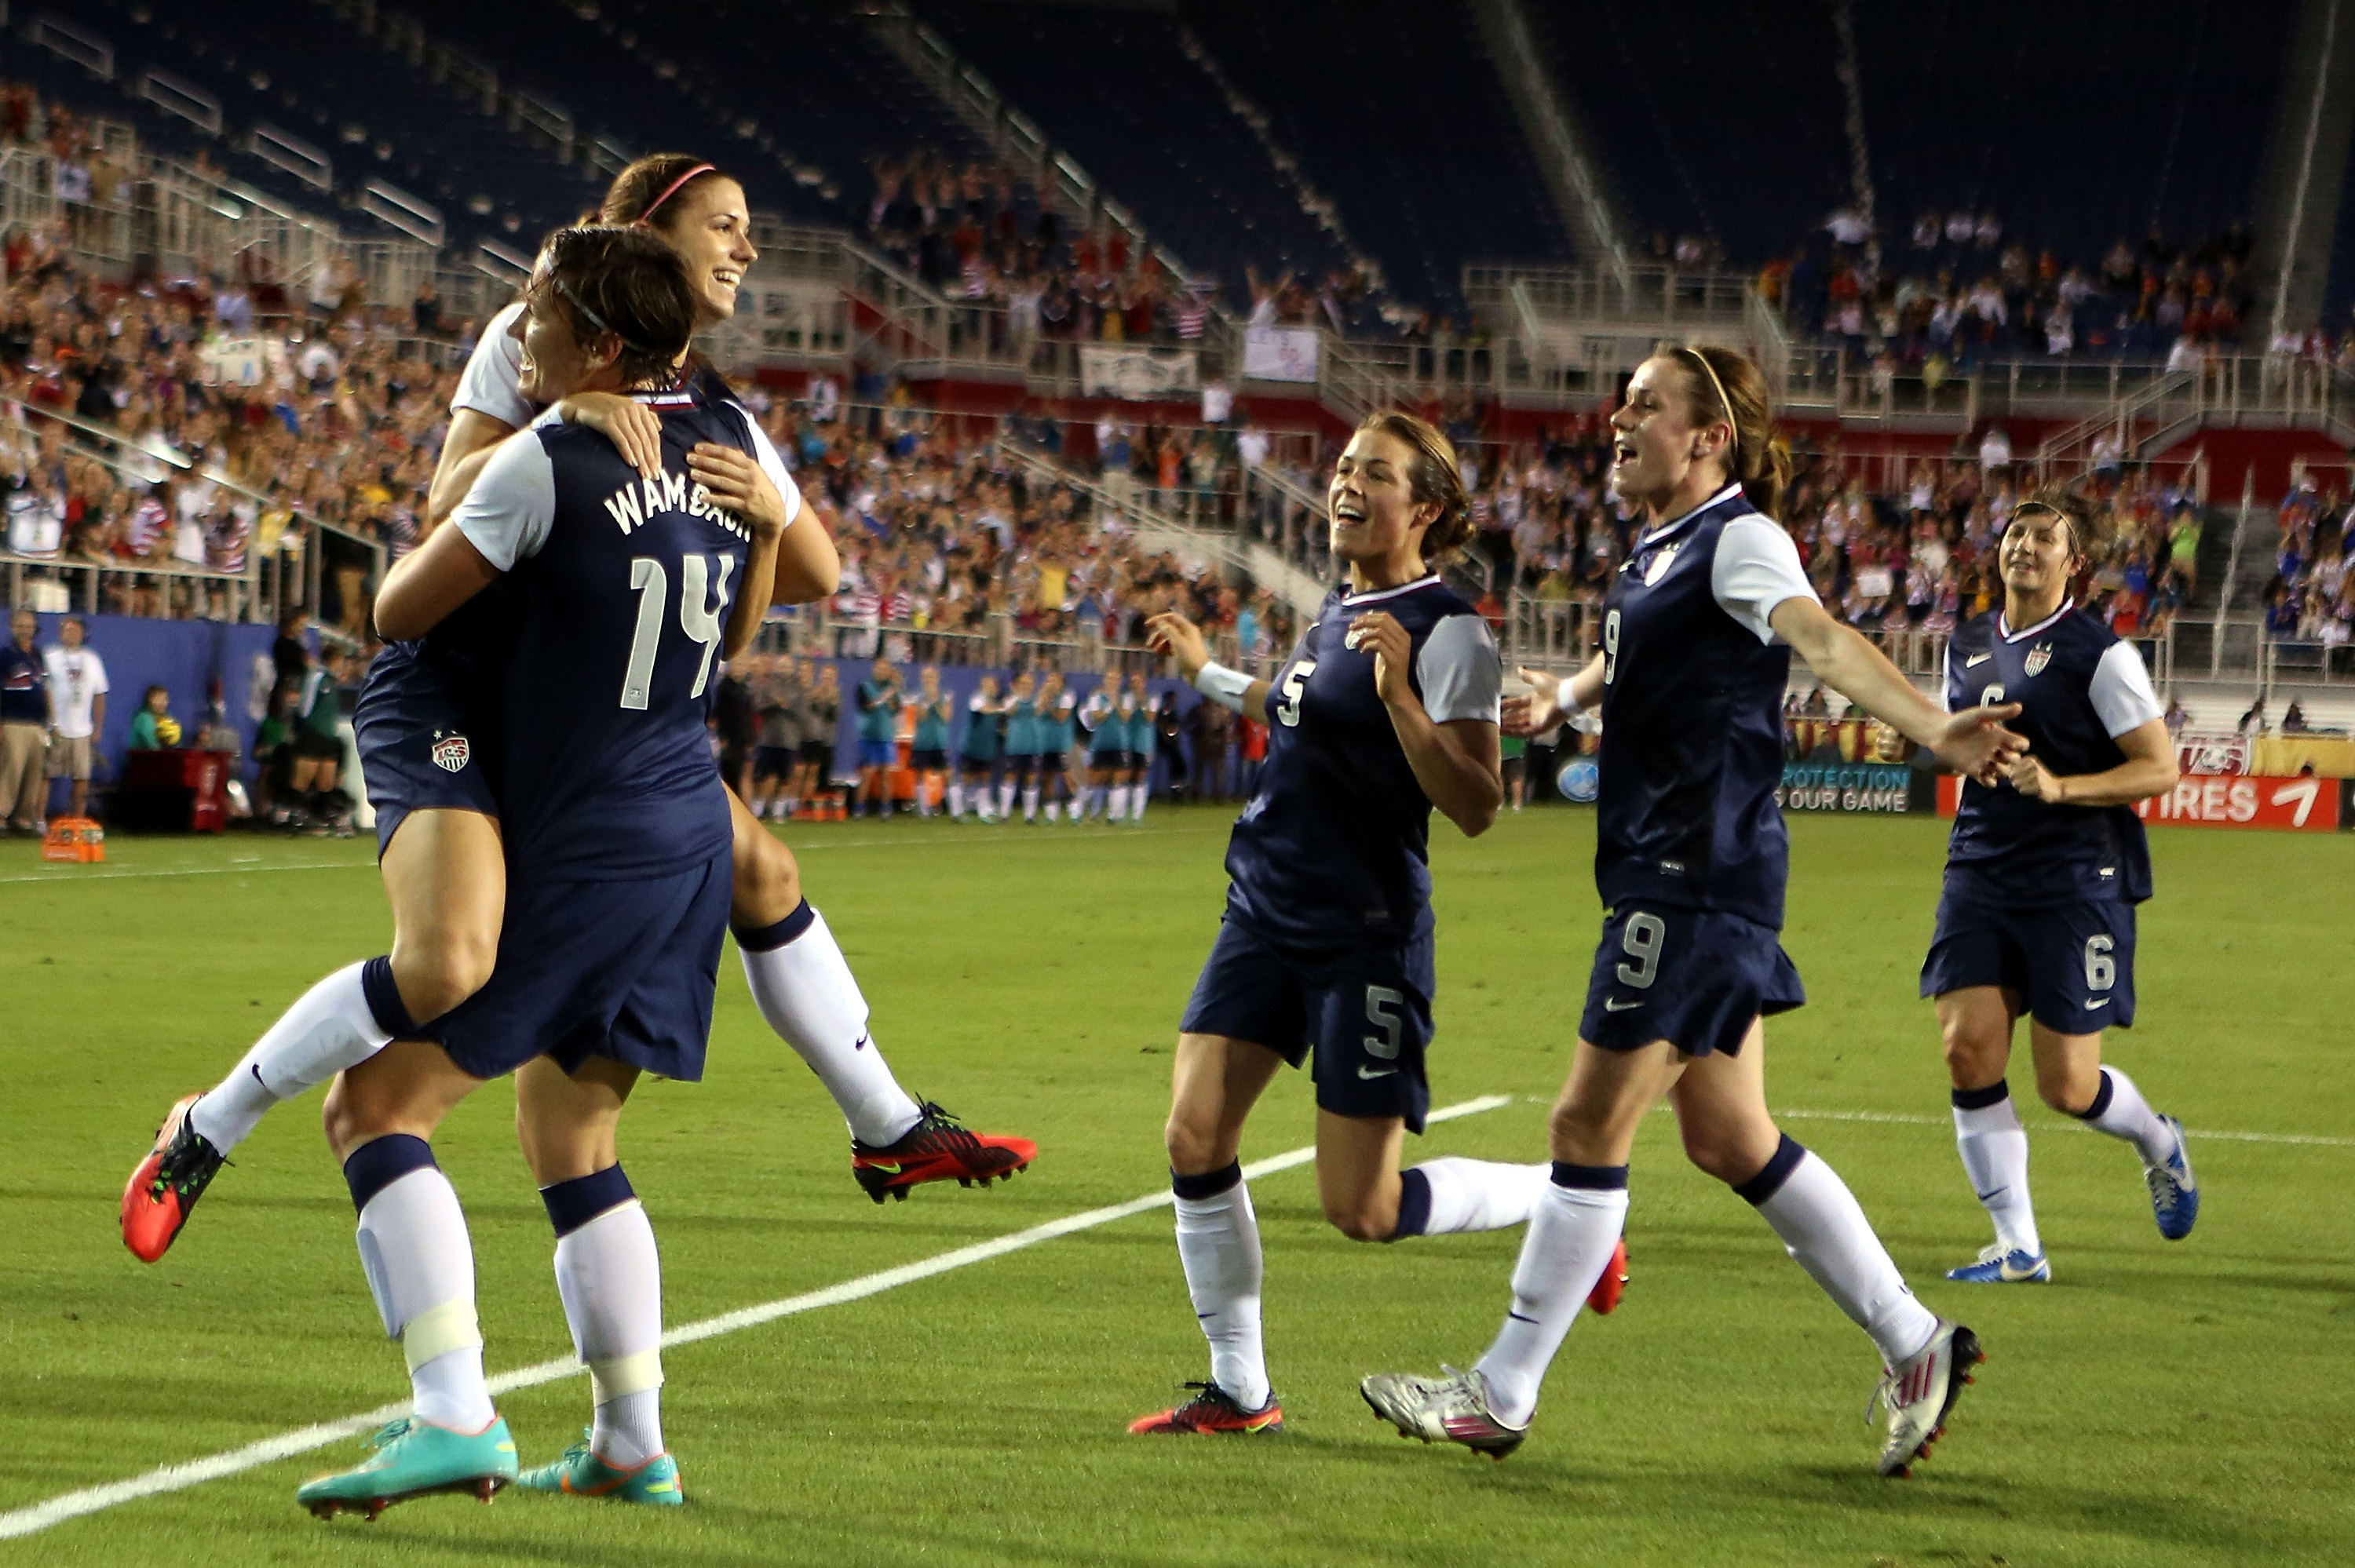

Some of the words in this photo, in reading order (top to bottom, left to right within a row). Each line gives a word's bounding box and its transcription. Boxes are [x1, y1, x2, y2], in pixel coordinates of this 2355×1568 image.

[620, 554, 735, 710] 14
[1277, 660, 1316, 727] 5
[1789, 789, 1838, 811] OUR
[1842, 790, 1909, 813] GAME
[1618, 912, 1665, 989] 9
[2085, 934, 2116, 991] 6
[1363, 985, 1404, 1059] 5
